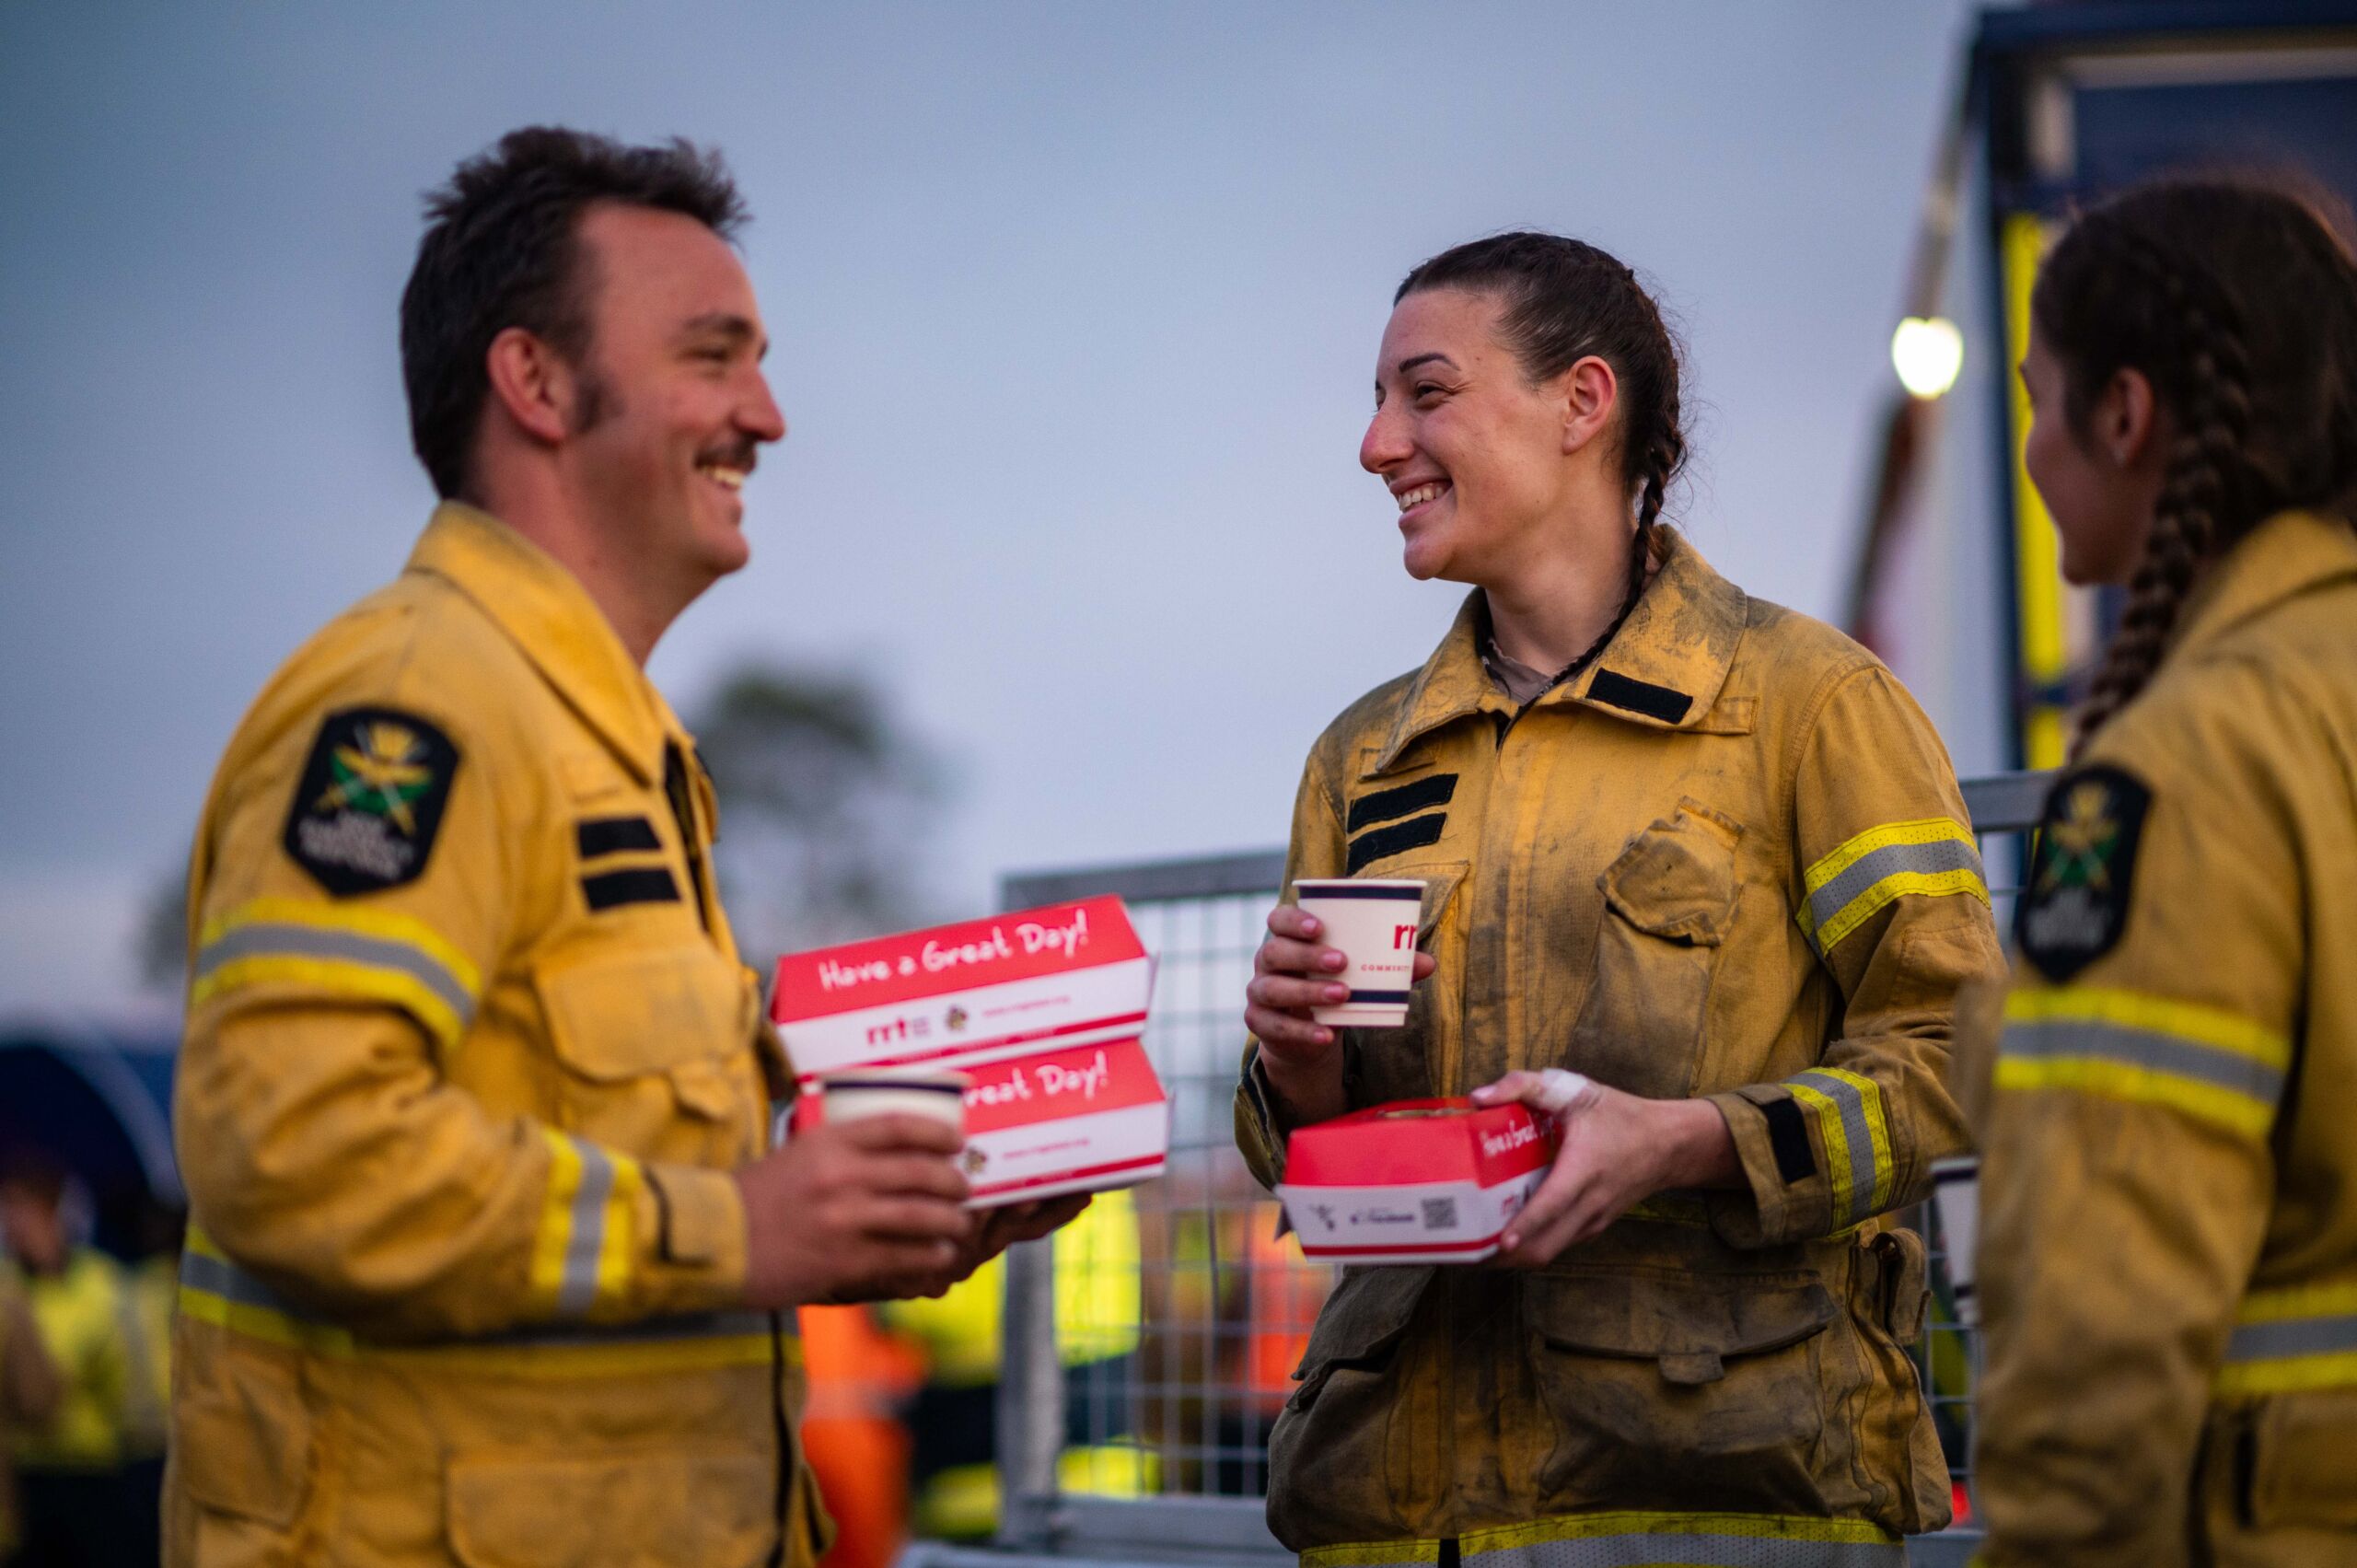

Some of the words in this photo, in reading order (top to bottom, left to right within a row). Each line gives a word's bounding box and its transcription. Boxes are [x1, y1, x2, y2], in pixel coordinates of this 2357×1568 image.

[819, 958, 891, 991] Have
[898, 956, 917, 976] a
[922, 925, 1013, 972] Great
[1016, 908, 1088, 958] Day!
[964, 1068, 1032, 1107] reat
[1035, 1050, 1109, 1100] Day!
